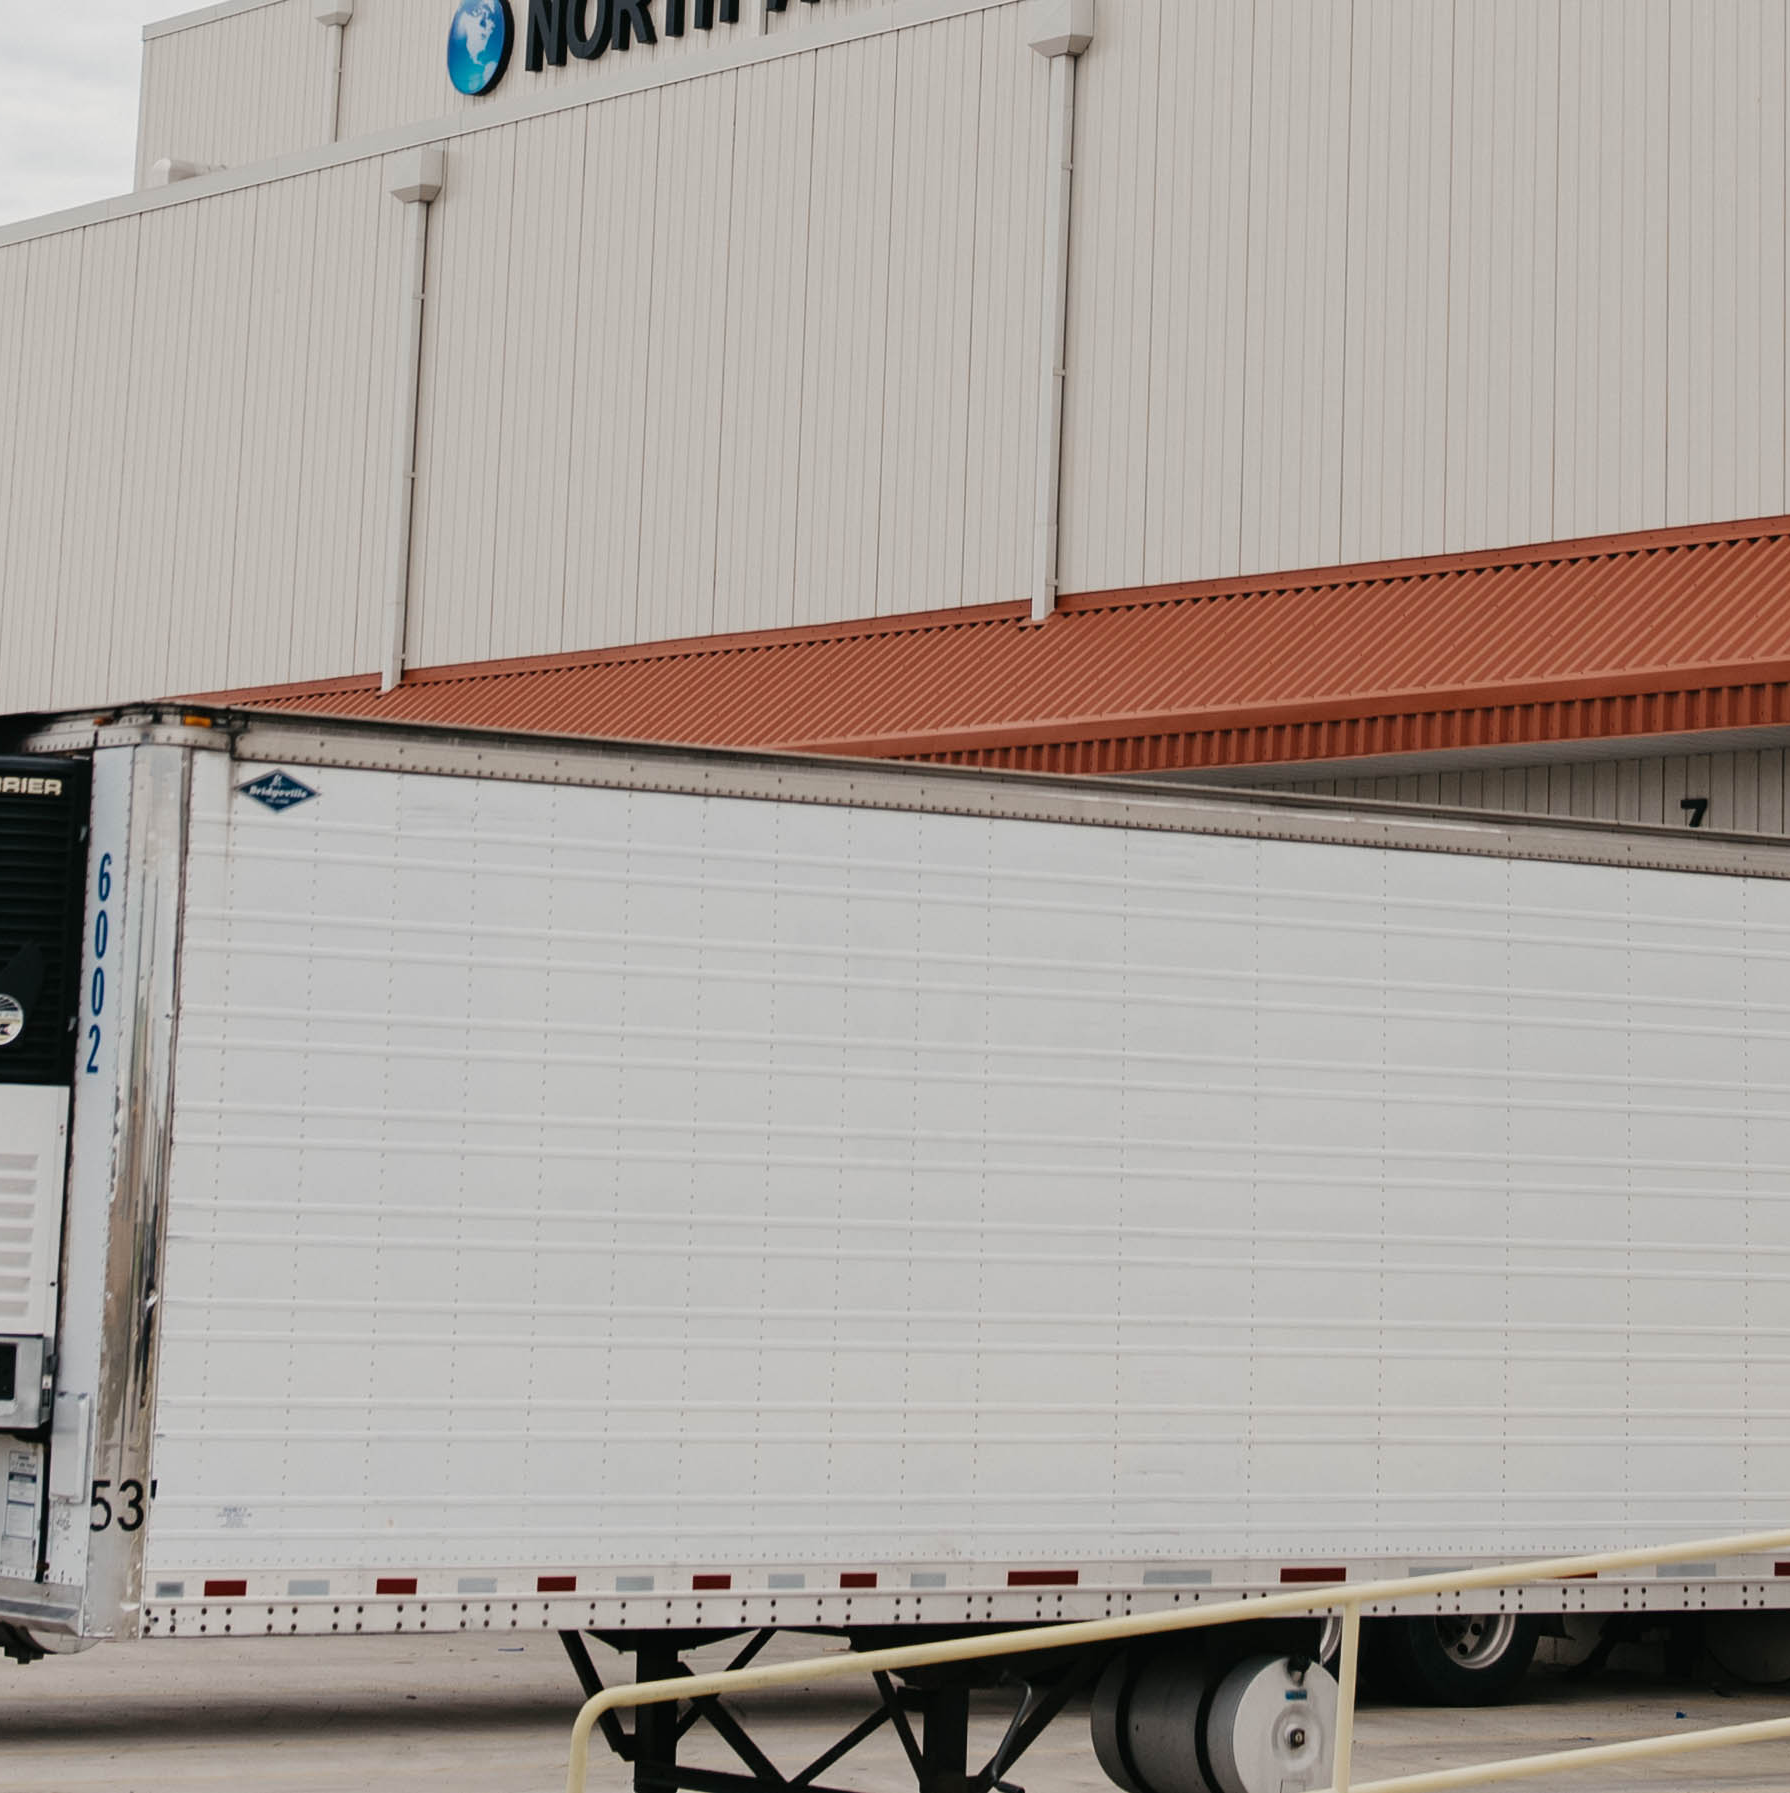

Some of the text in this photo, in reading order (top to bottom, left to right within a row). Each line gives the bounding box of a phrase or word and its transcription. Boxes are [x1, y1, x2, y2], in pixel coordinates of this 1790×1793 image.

[1680, 798, 1708, 827] 7
[87, 852, 112, 1074] 6002
[90, 1479, 158, 1531] 53'
